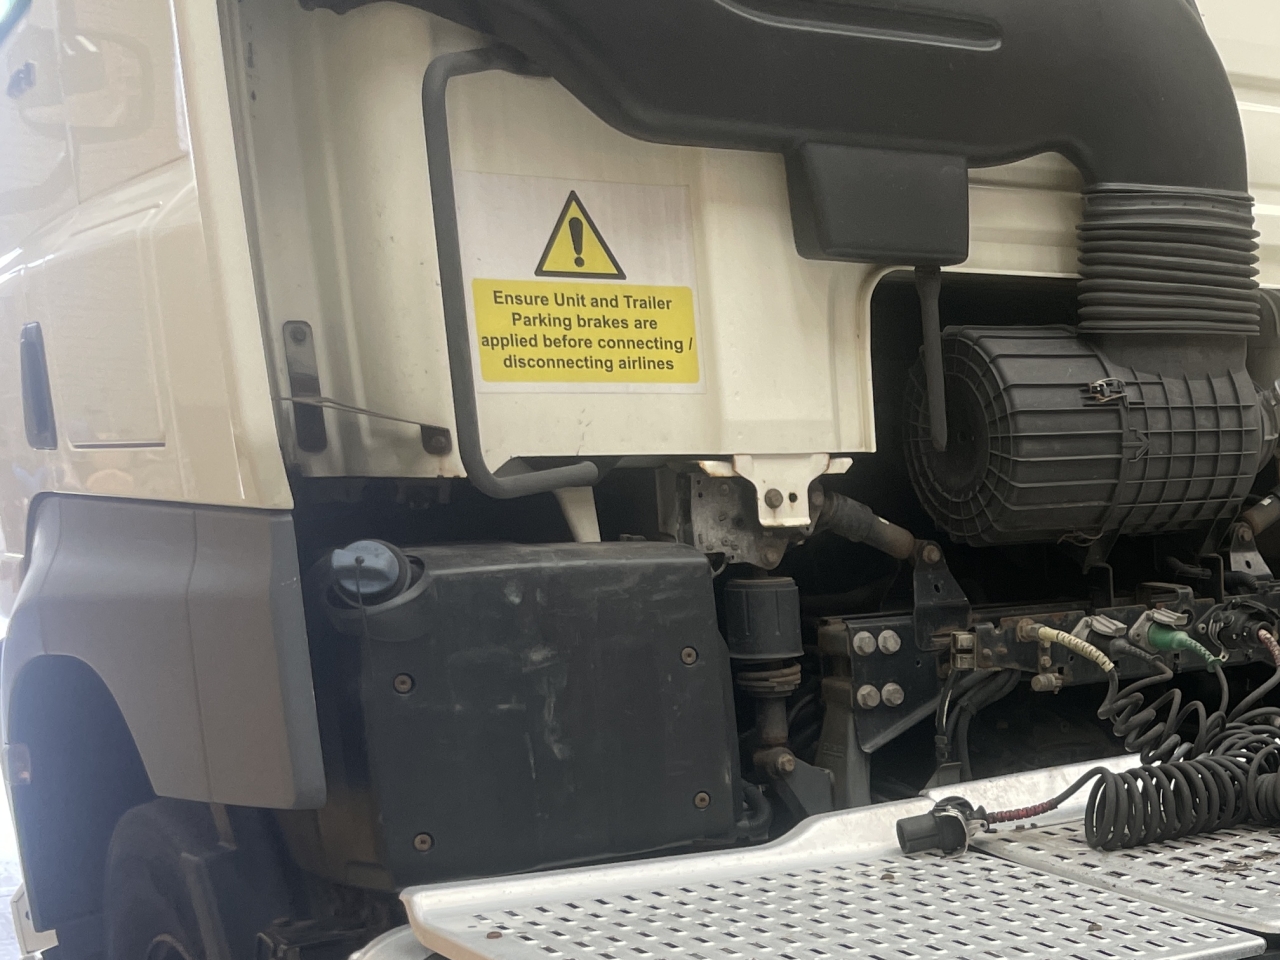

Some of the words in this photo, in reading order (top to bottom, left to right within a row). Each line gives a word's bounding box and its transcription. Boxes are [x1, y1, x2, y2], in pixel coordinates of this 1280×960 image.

[493, 290, 549, 306] Ensure
[554, 293, 586, 308] Unit
[590, 294, 619, 308] and
[623, 295, 672, 310] Trailer
[512, 312, 572, 331] Parking
[577, 314, 629, 329] brakes
[634, 318, 658, 330] are
[481, 334, 538, 350] applied
[543, 335, 593, 349] before
[598, 337, 684, 353] connecting
[503, 354, 614, 373] disconnecting
[618, 356, 674, 370] airlines
